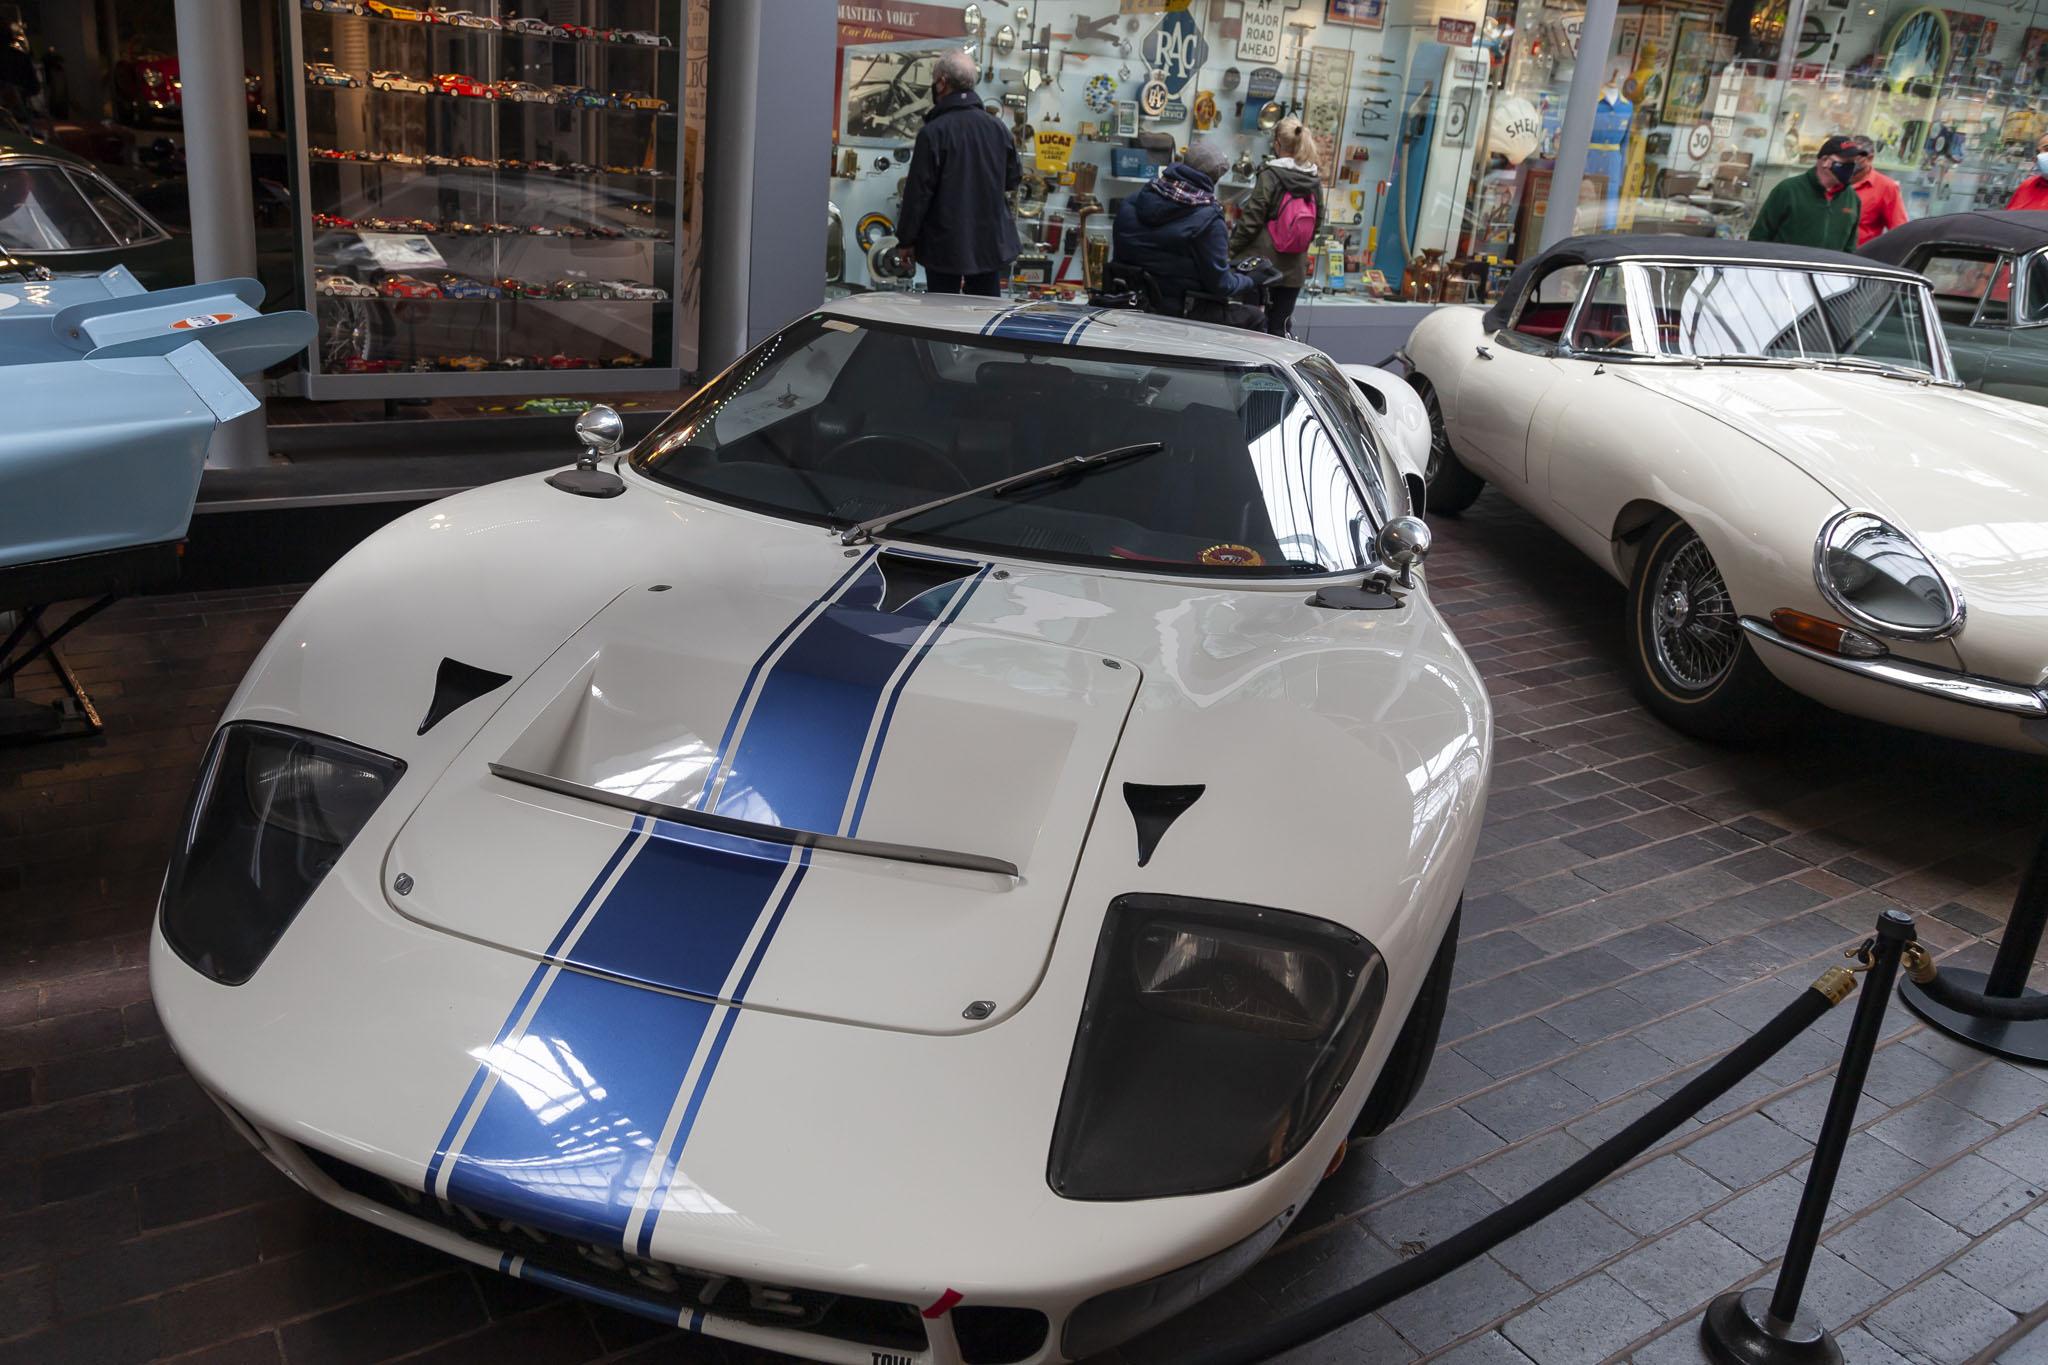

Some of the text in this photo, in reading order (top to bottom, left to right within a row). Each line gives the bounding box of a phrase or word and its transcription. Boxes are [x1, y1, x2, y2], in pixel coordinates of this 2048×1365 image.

[1245, 12, 1279, 28] MAJOR
[842, 26, 894, 40] Car Radio
[1246, 27, 1274, 41] ROAD
[1154, 21, 1198, 77] RAC
[1240, 42, 1276, 57] AHEAD
[1149, 85, 1166, 108] RAC
[1506, 118, 1538, 138] SHELL
[1039, 134, 1072, 147] LUCAS
[1693, 133, 1709, 149] 30
